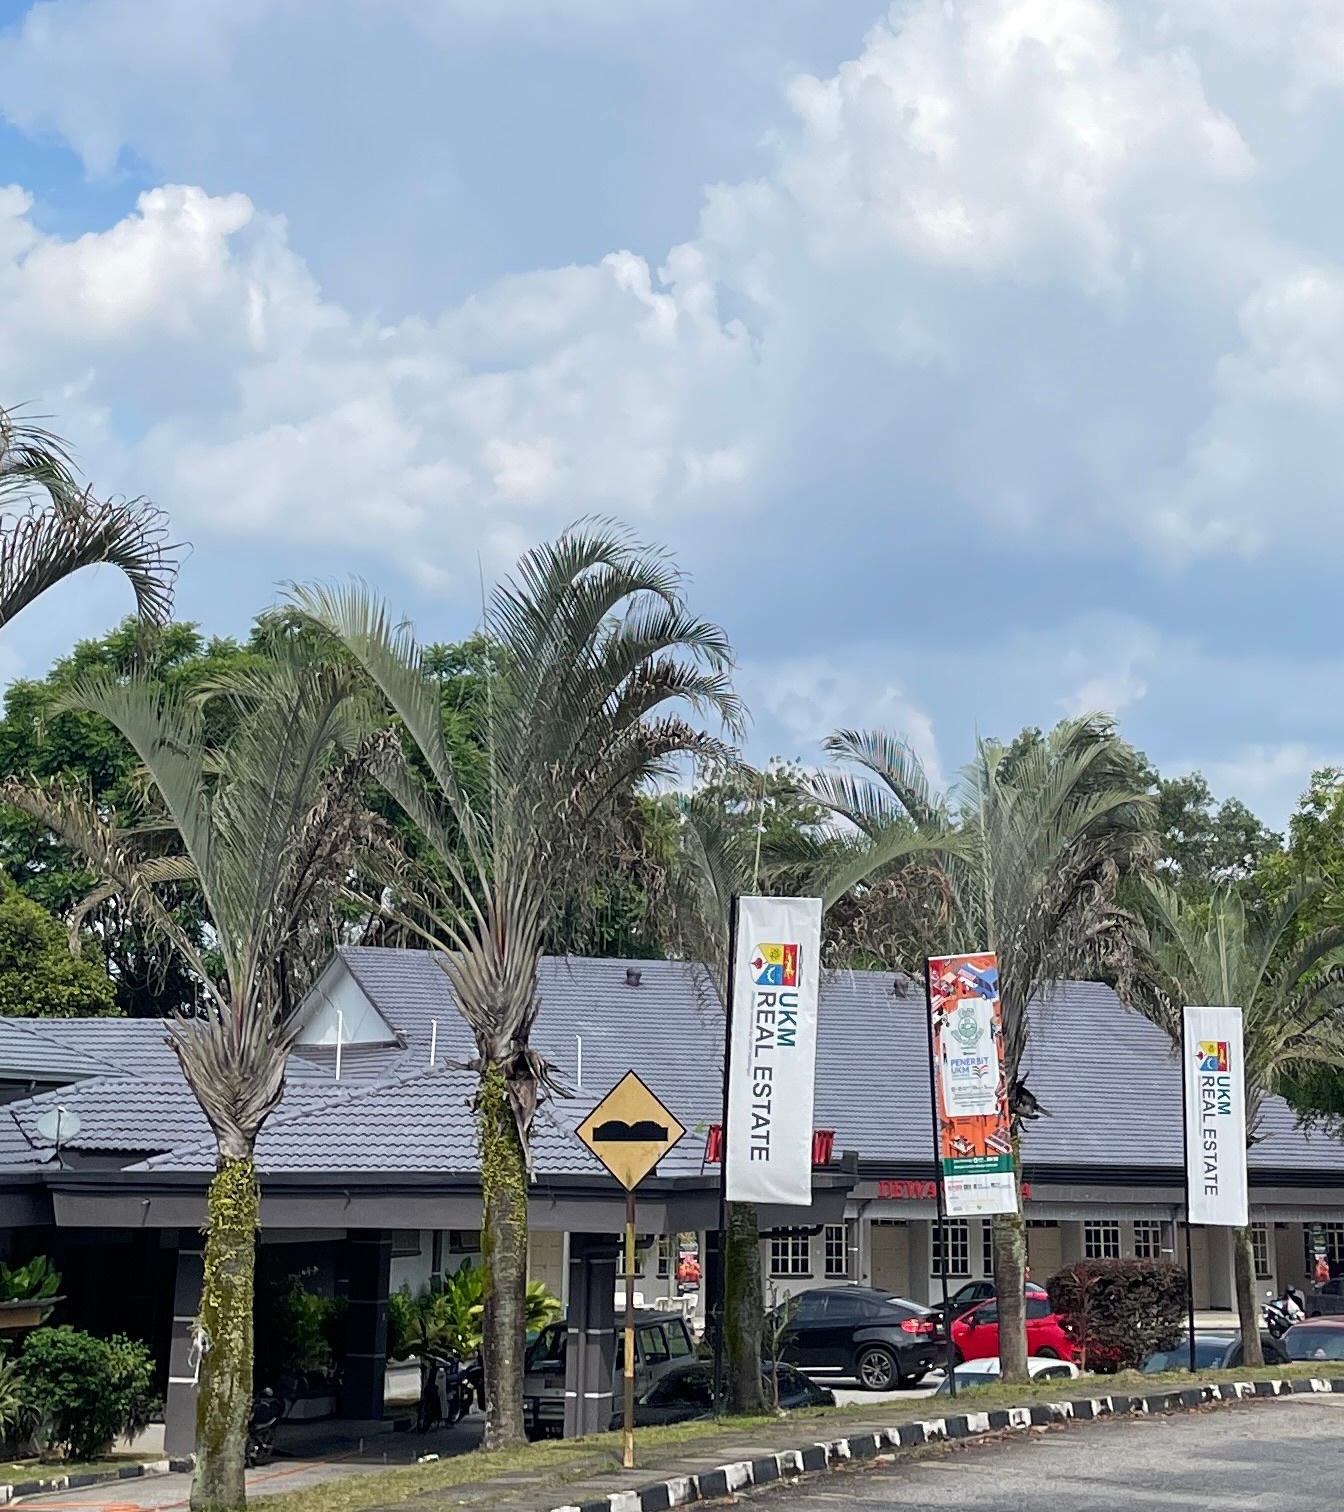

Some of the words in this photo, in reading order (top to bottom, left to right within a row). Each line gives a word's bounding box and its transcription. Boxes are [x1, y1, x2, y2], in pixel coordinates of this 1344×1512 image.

[754, 991, 775, 1057] REAL
[776, 992, 798, 1046] UKM
[750, 1065, 772, 1162] ESTATE
[1201, 1075, 1216, 1123] REAL
[1216, 1075, 1232, 1116] UKM
[1203, 1128, 1219, 1196] ESTATE
[879, 1180, 944, 1200] DEWA
